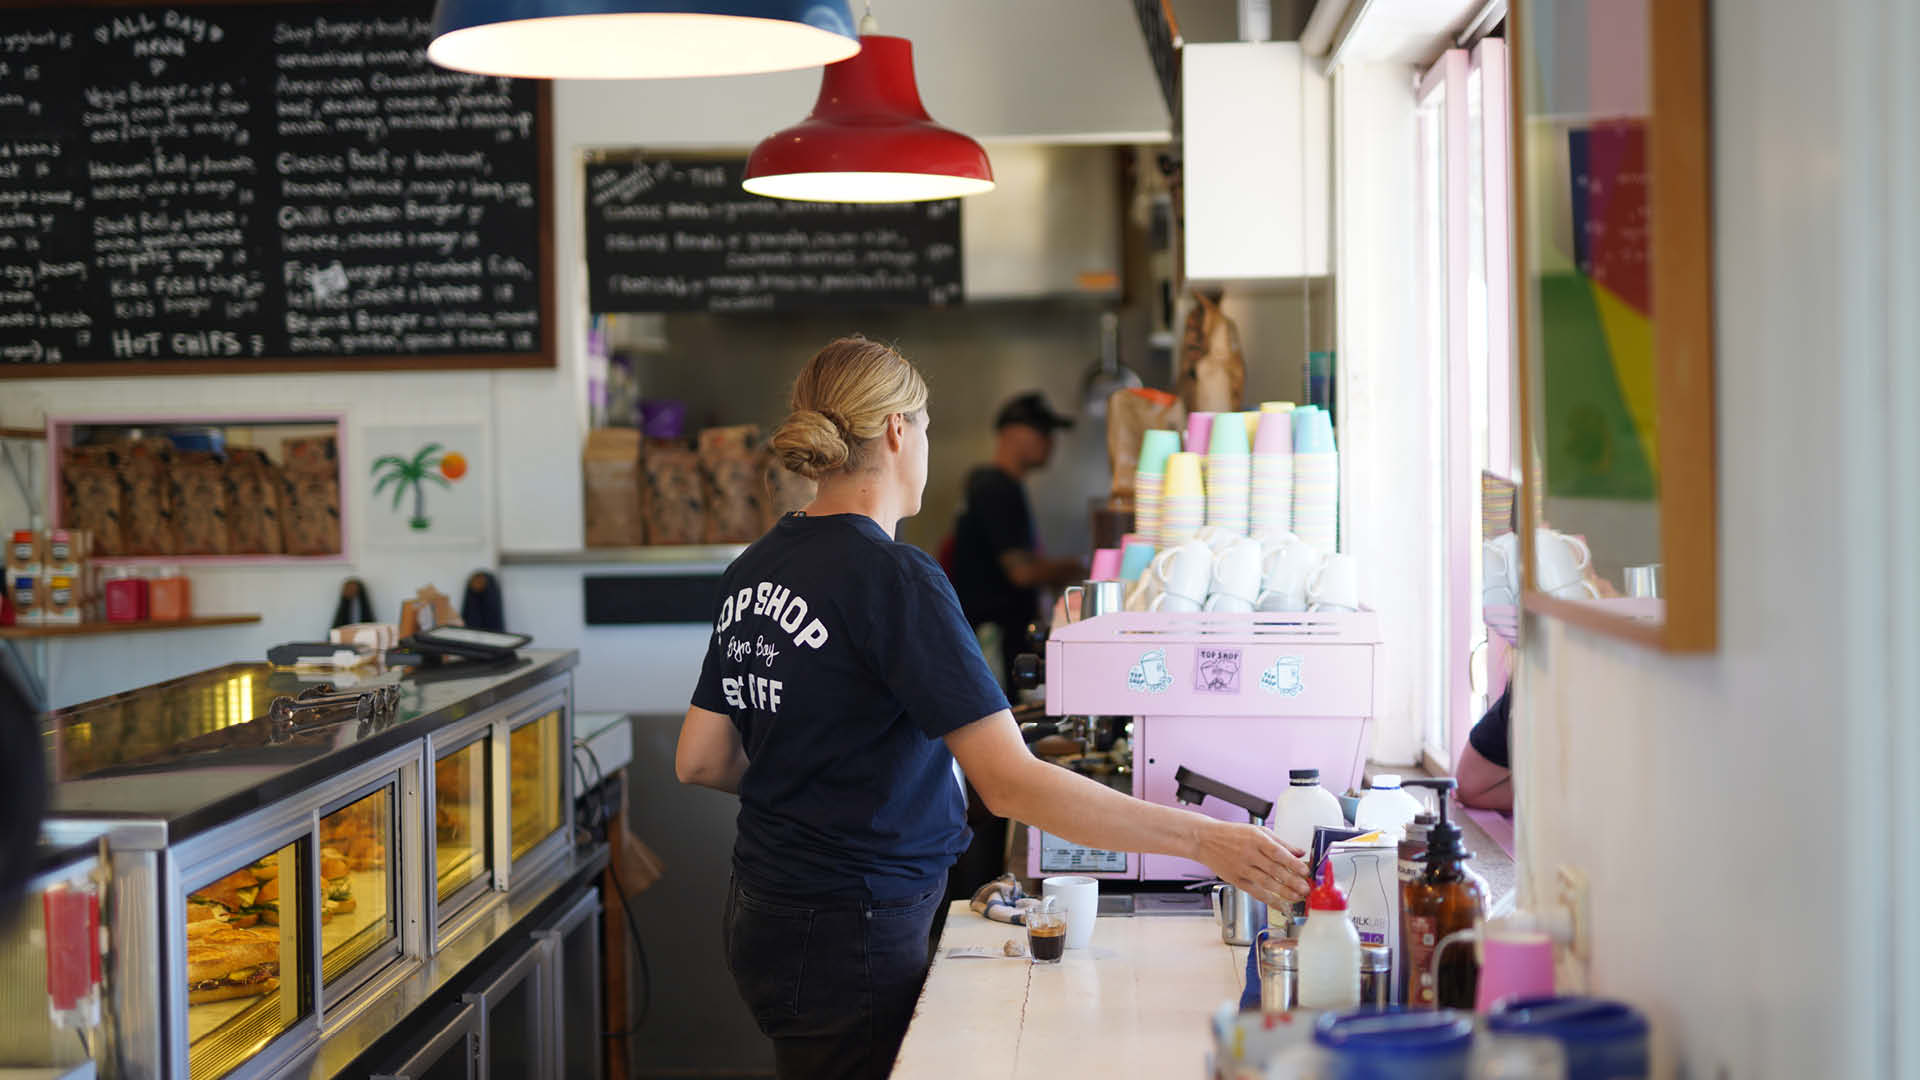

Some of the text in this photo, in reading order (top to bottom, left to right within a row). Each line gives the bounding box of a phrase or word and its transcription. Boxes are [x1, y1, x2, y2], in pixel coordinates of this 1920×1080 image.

[112, 9, 207, 43] ALL DAY
[133, 37, 186, 57] MENU
[276, 151, 345, 174] Classic
[348, 148, 390, 172] Beef
[278, 203, 332, 230] Chilli
[334, 203, 402, 226] Chicken
[404, 199, 465, 226] Burger
[354, 308, 420, 338] Burger
[111, 328, 163, 357] HOT
[170, 328, 244, 357] CHIPS
[717, 582, 829, 649] OP SHOP
[756, 634, 780, 667] Bay
[1200, 650, 1239, 660] TOP SHOP
